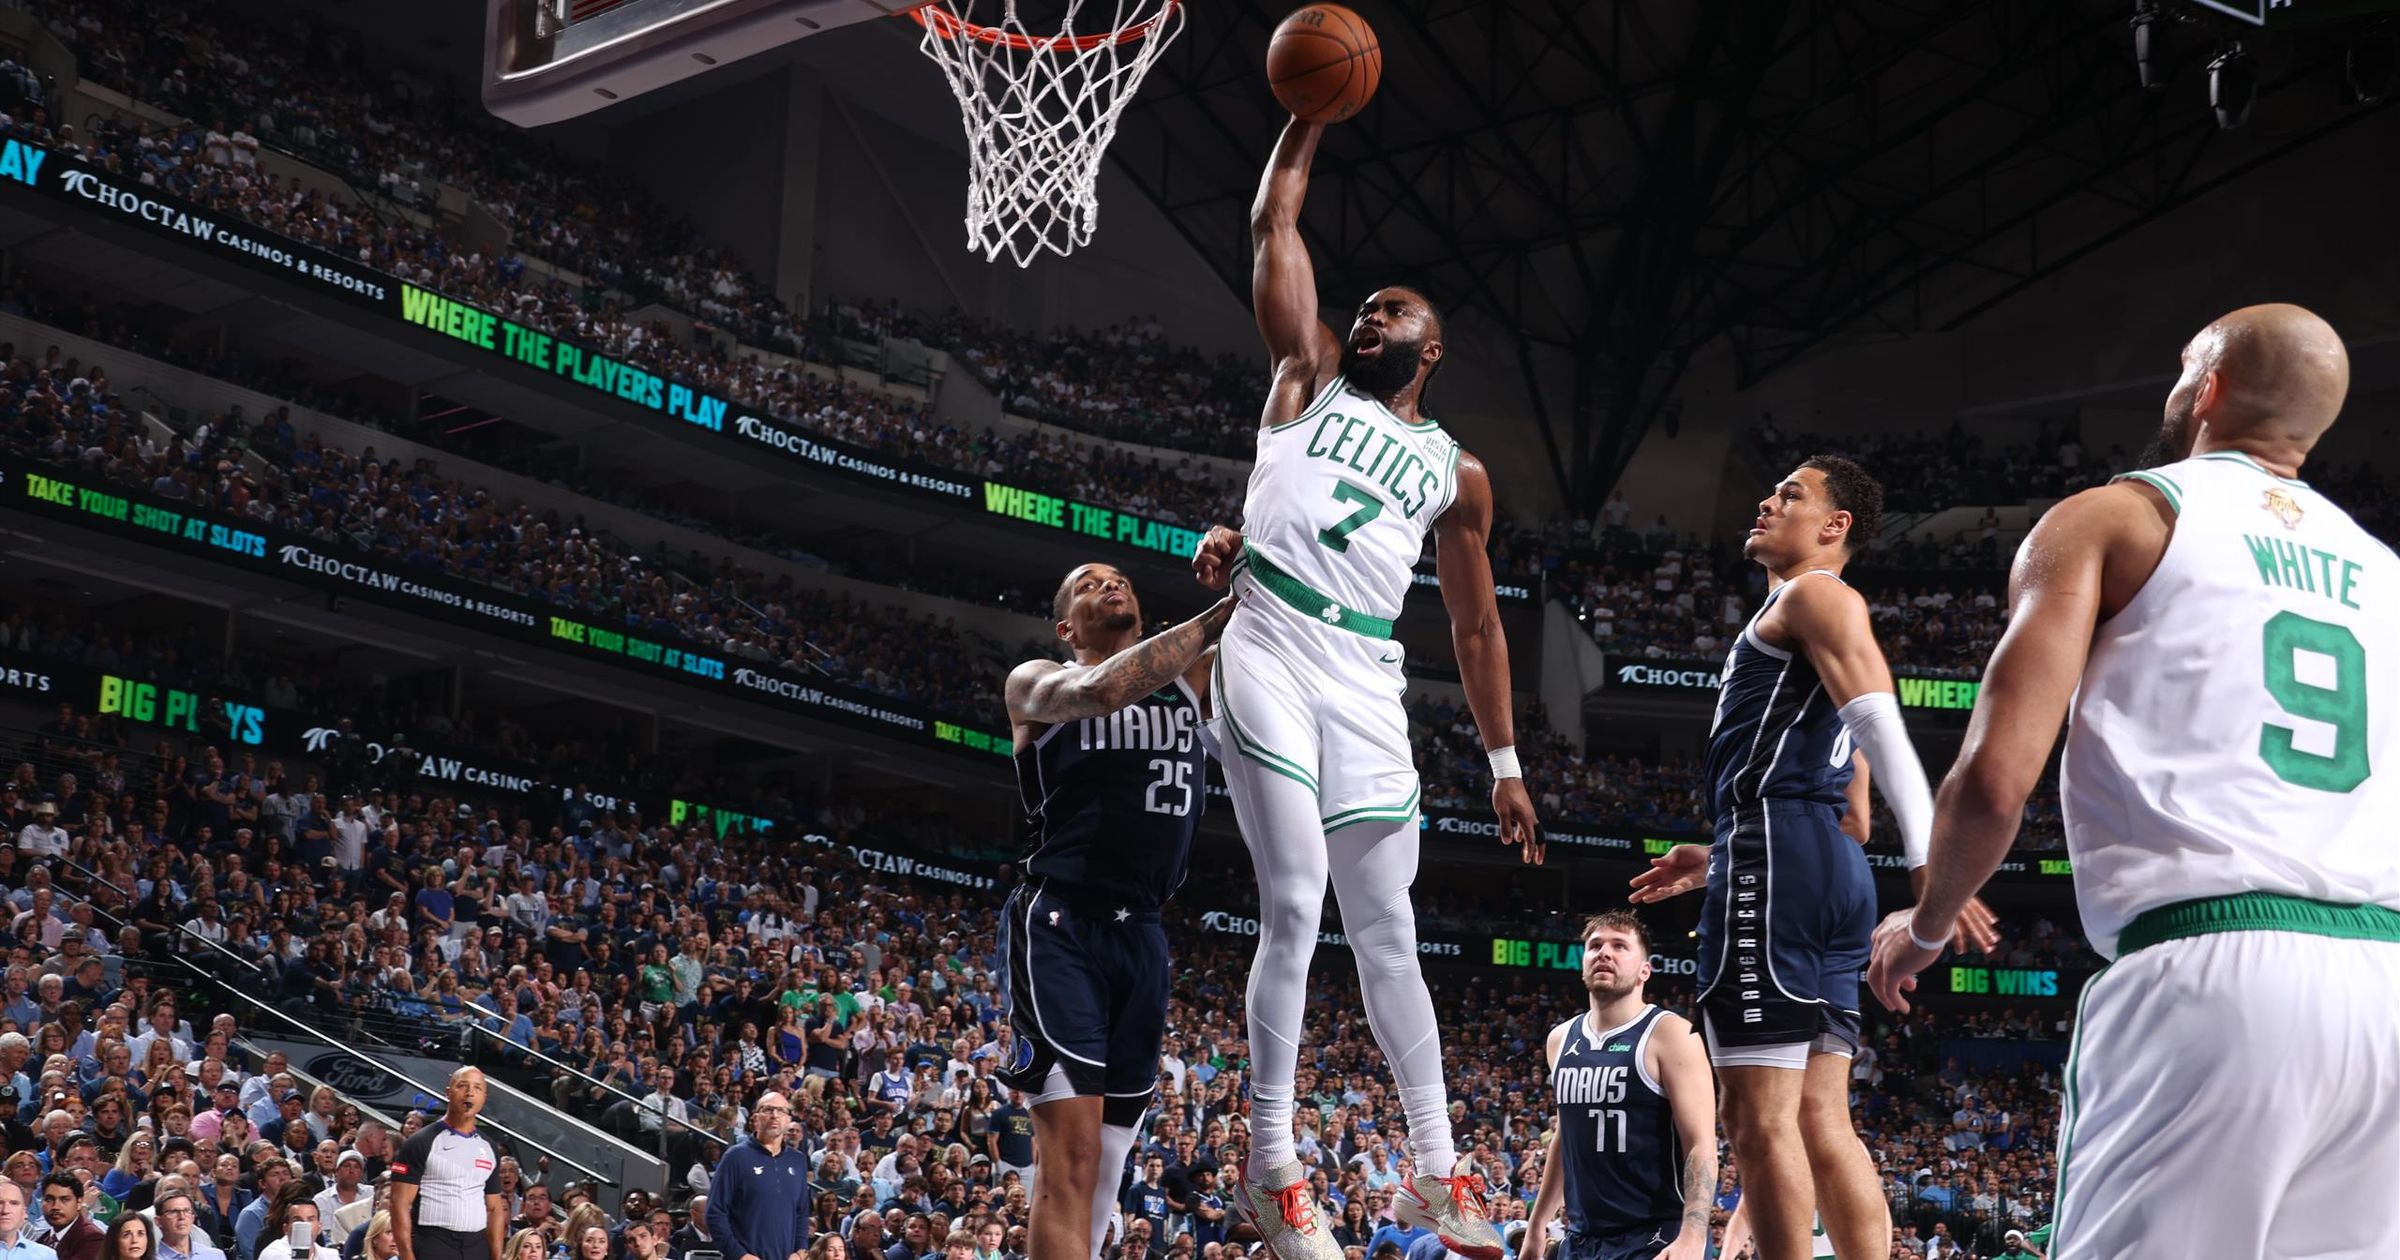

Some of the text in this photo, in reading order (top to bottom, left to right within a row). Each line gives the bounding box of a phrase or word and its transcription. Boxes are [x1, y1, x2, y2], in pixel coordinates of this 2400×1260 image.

[0, 139, 46, 186] AY
[76, 174, 385, 300] CHOCTAW CASINOS & RESORTS
[402, 284, 727, 432] WHERE THE PLAYERS PLAY
[745, 418, 972, 499] CHOCTAW CASINOS & RESORTS
[1306, 412, 1439, 520] CELTICS
[25, 473, 267, 558] TAKE YOUR SHOT AT SLOTS
[984, 482, 1204, 558] WHERE THE PLAYER
[1317, 479, 1384, 553] 7
[292, 548, 536, 627] CHOCTAW CASINOS & RESORTS
[1495, 585, 1529, 600] ORTS
[2243, 534, 2363, 610] WHITE
[550, 616, 725, 680] TAKE YOUR SHOT AT SLOTS
[1630, 665, 1719, 688] CHOCTA
[99, 674, 155, 722] BIG
[165, 688, 265, 745] PLYS
[744, 669, 924, 731] CHOCTAW CASINOS & RESORTS
[2258, 610, 2371, 794] 9
[465, 767, 534, 793] CASINO
[1145, 759, 1192, 817] 25
[1447, 817, 1500, 837] CHOCT
[914, 863, 972, 887] CASINOS
[974, 876, 984, 889] &
[1416, 941, 1462, 957] ORTS
[1492, 938, 1583, 972] BIG PLA
[1950, 967, 2059, 997] BIG WINS
[325, 1058, 387, 1092] Ford
[1557, 1066, 1628, 1105] MAVS
[1589, 1109, 1626, 1153] 77
